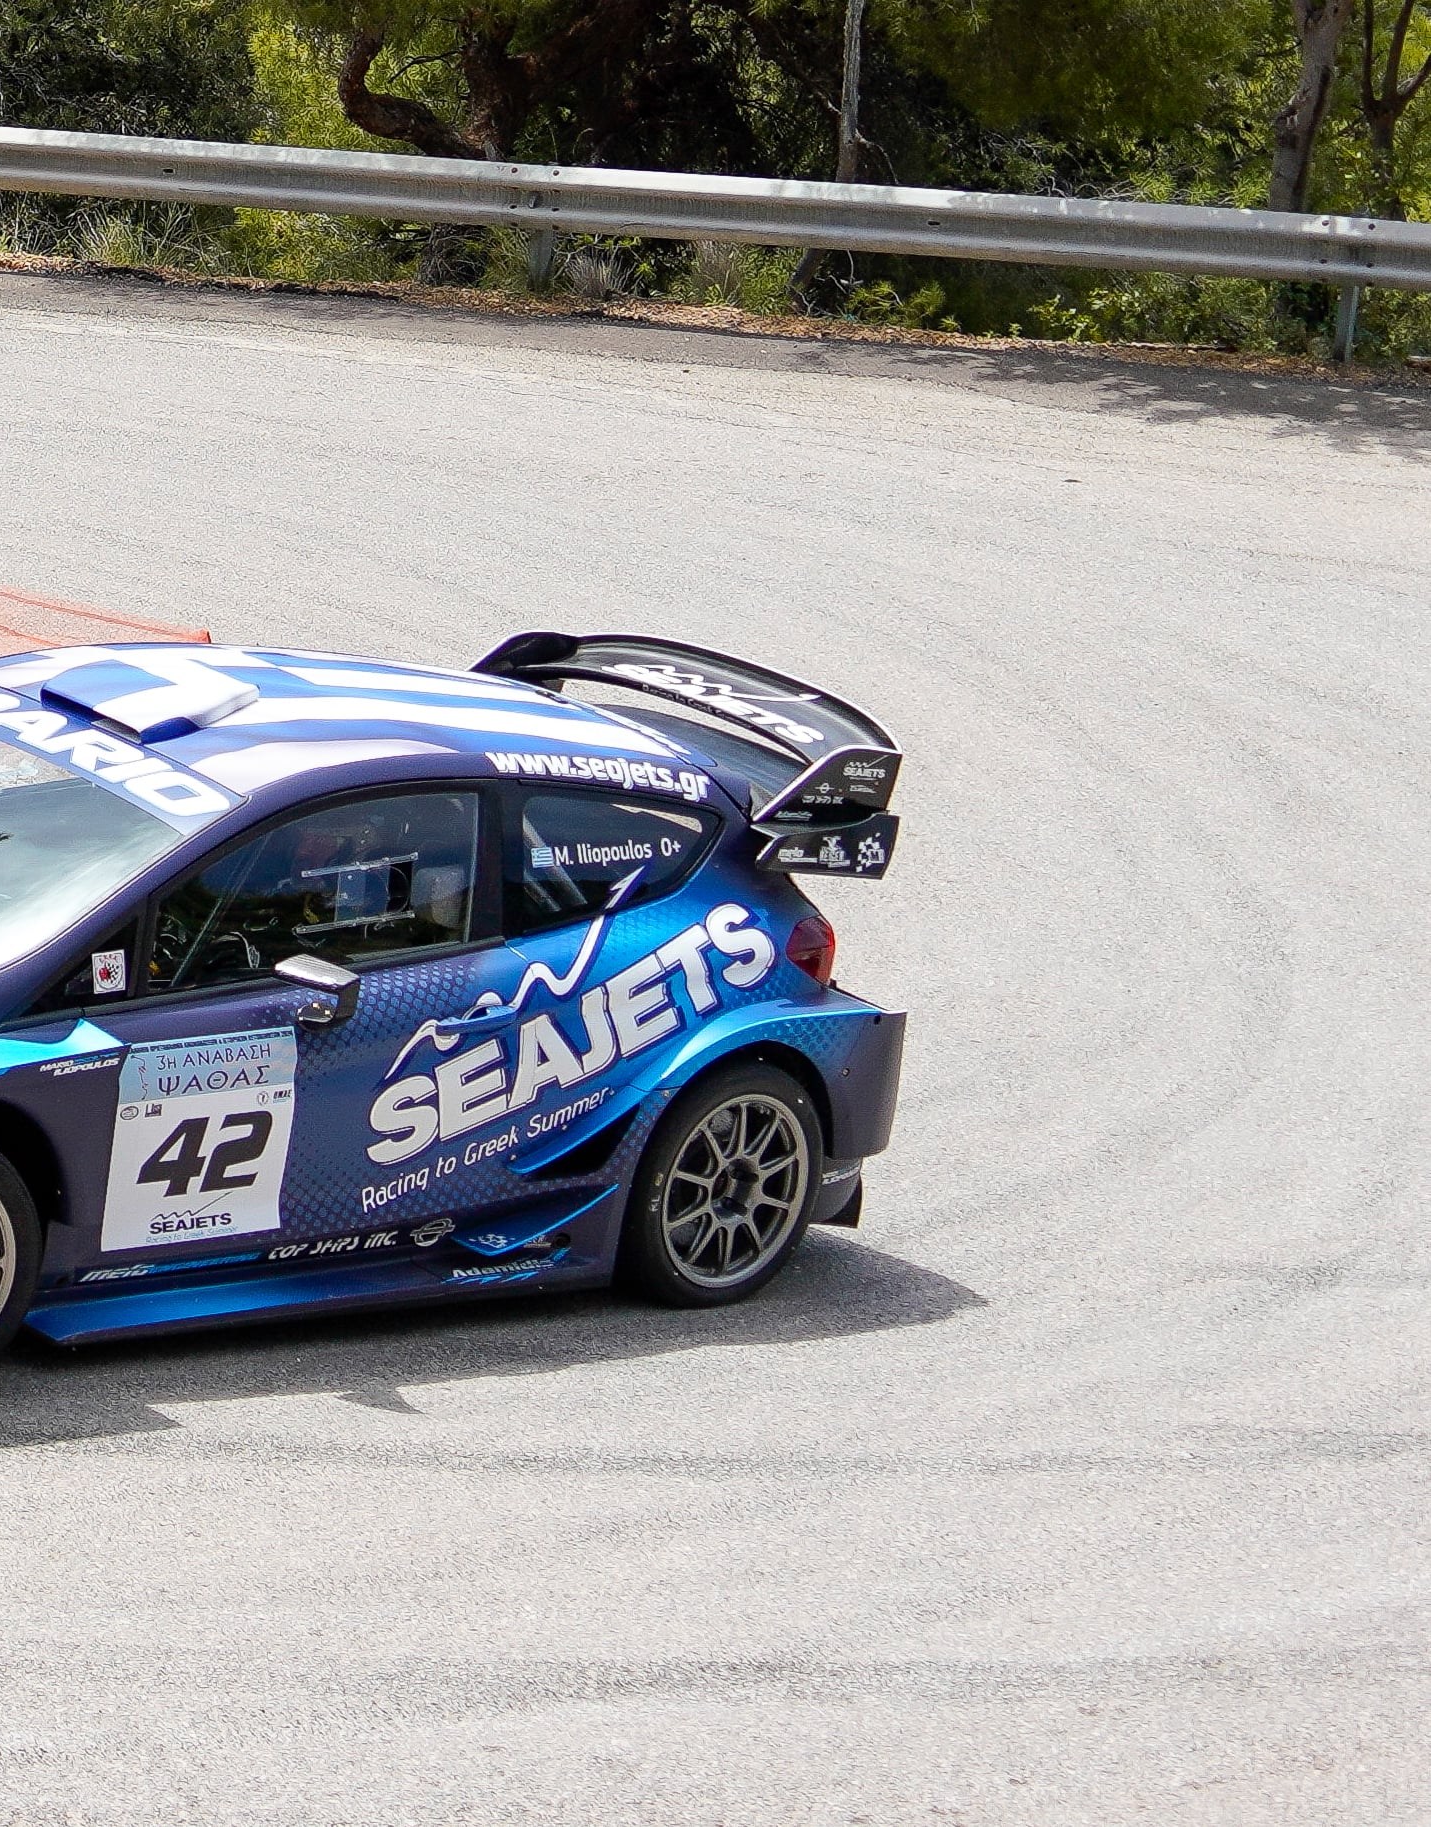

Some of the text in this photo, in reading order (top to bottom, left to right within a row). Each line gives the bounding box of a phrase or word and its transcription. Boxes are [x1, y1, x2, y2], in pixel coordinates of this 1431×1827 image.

[601, 664, 824, 743] SEAJETS
[554, 846, 574, 866] M.
[577, 839, 652, 867] Iliopoulos
[182, 1043, 271, 1067] ΑΝΑΒΑΣΗ
[367, 903, 776, 1165] SEAJETS
[158, 1065, 271, 1096] ΨΑΘΑΣ
[136, 1111, 273, 1198] 42
[361, 1087, 610, 1213] Racing to Greek Summer
[149, 1212, 232, 1234] SEAJETS
